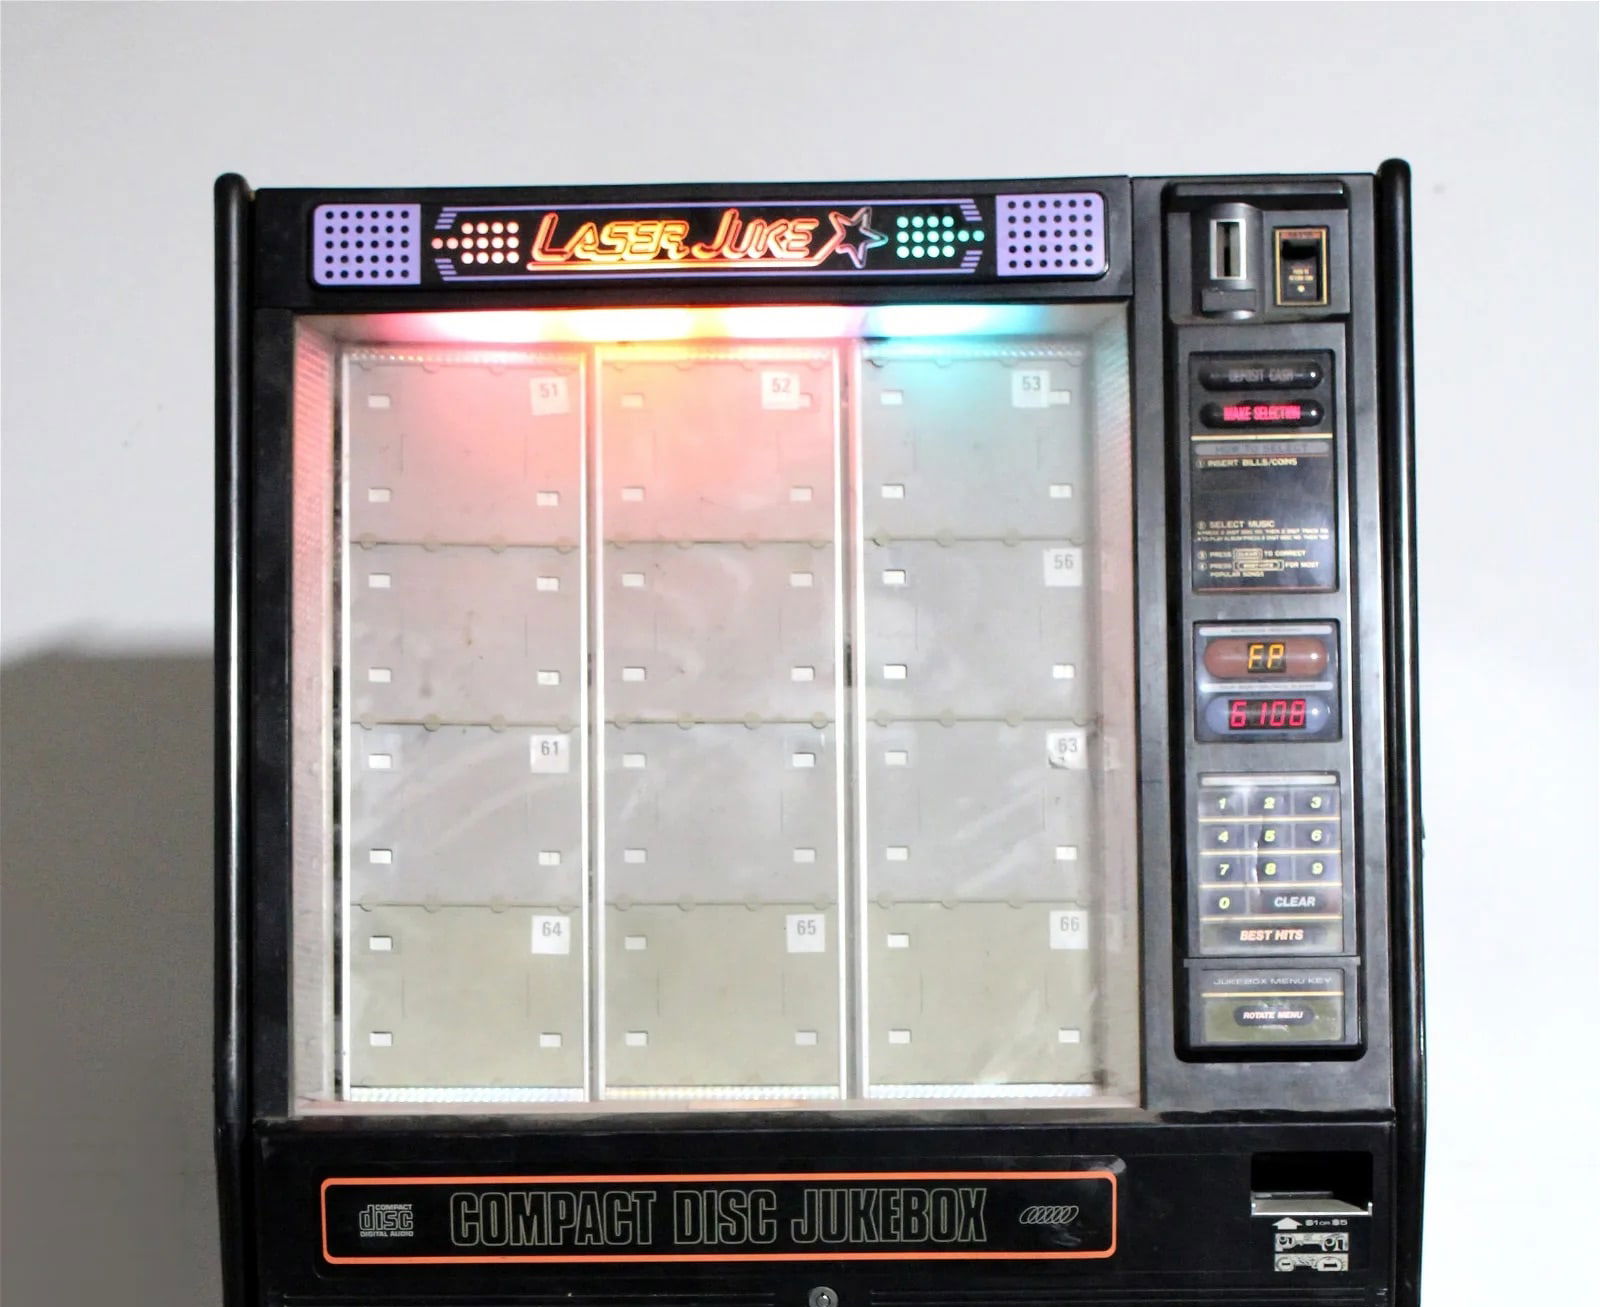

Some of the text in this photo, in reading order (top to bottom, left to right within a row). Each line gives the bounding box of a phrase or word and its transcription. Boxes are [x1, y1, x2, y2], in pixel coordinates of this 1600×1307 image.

[772, 378, 791, 393] 52
[1022, 376, 1041, 391] 53
[540, 383, 558, 398] 51
[1253, 405, 1301, 420] SELECTION
[1208, 520, 1245, 528] SELECT
[1248, 520, 1275, 528] MUSIC
[1054, 554, 1074, 570] 56
[1247, 643, 1285, 669] FP
[541, 740, 559, 756] 61
[1058, 738, 1077, 753] 63
[1218, 798, 1227, 809] 1
[1264, 797, 1275, 809] 2
[1310, 797, 1322, 808] 3
[1218, 830, 1228, 843] 4
[1264, 830, 1276, 842] 5
[1311, 829, 1322, 841] 6
[1219, 864, 1230, 876] 7
[1265, 862, 1276, 875] 8
[1312, 862, 1323, 875] 9
[1219, 897, 1230, 909] 0
[1274, 896, 1316, 908] CLEAR
[542, 922, 562, 937] 64
[797, 920, 816, 935] 65
[1060, 916, 1079, 932] 66
[1240, 929, 1304, 941] BEST HITS
[1270, 977, 1305, 985] MENU
[1308, 977, 1332, 985] KEY
[1243, 1011, 1304, 1020] ROTATE MENU
[450, 1187, 987, 1246] COMPACT DISC JUKEBOX
